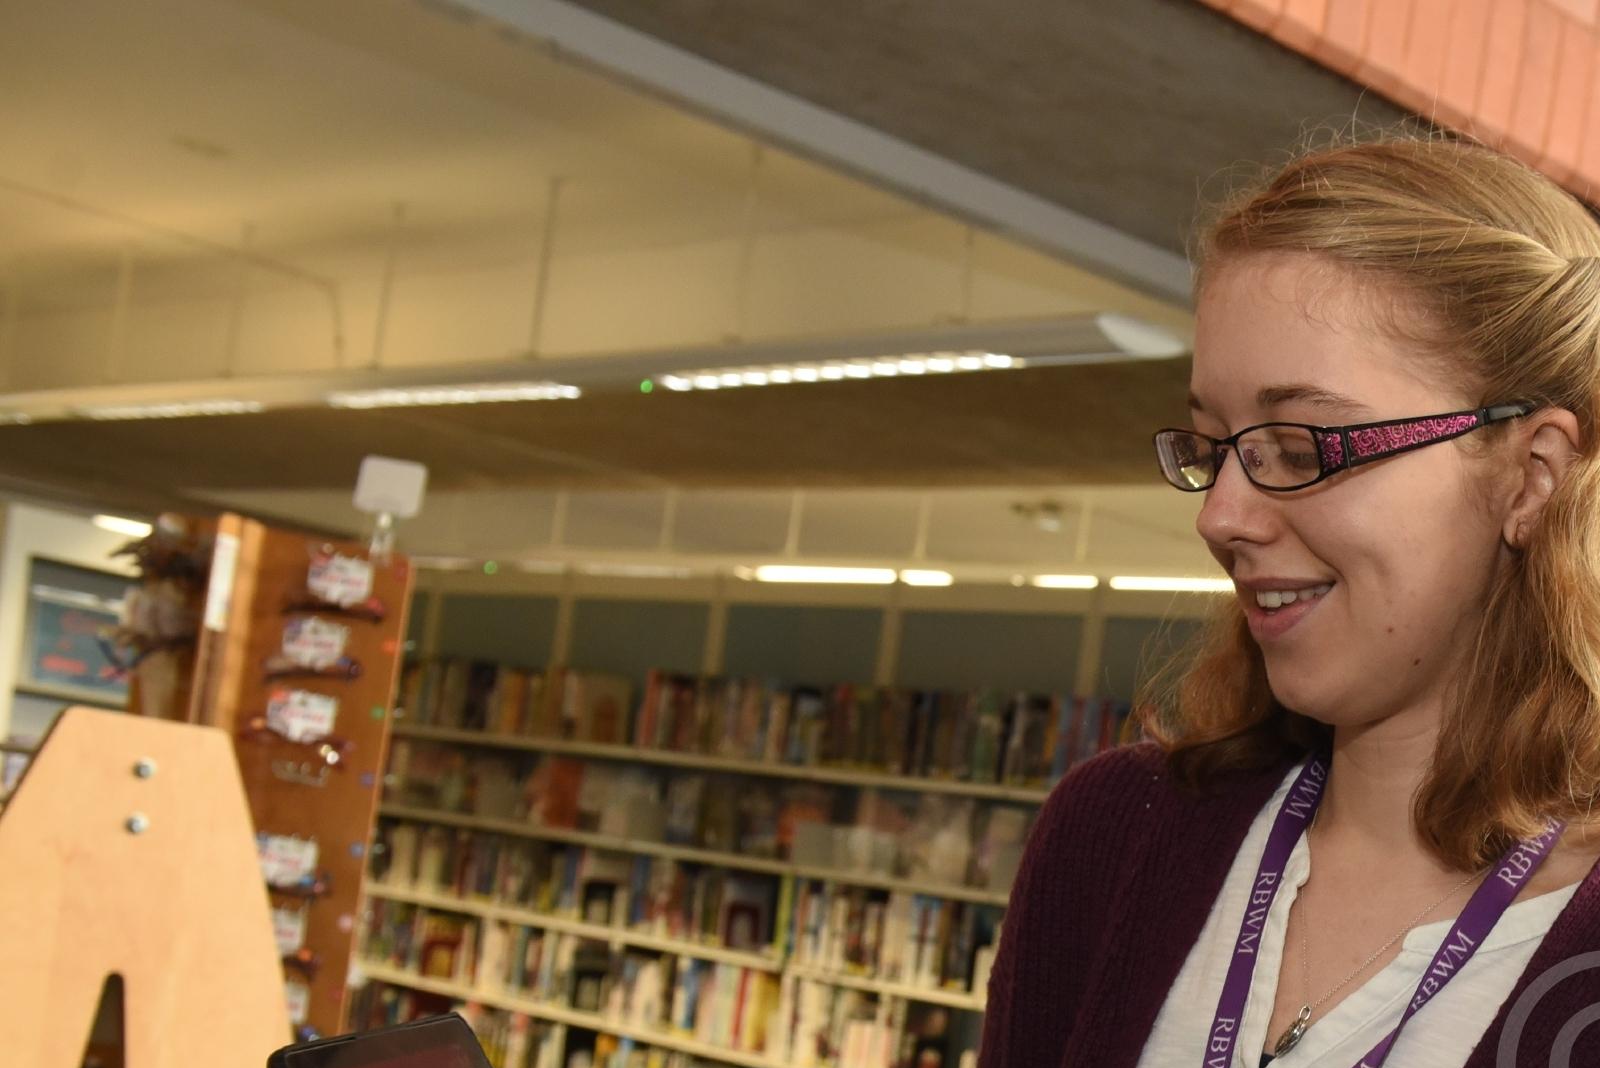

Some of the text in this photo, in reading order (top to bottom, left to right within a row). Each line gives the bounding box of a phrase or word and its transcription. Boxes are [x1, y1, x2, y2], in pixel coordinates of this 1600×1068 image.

[1285, 761, 1326, 819] BWM
[1237, 871, 1278, 954] RBWM
[1412, 929, 1475, 1010] RBWM
